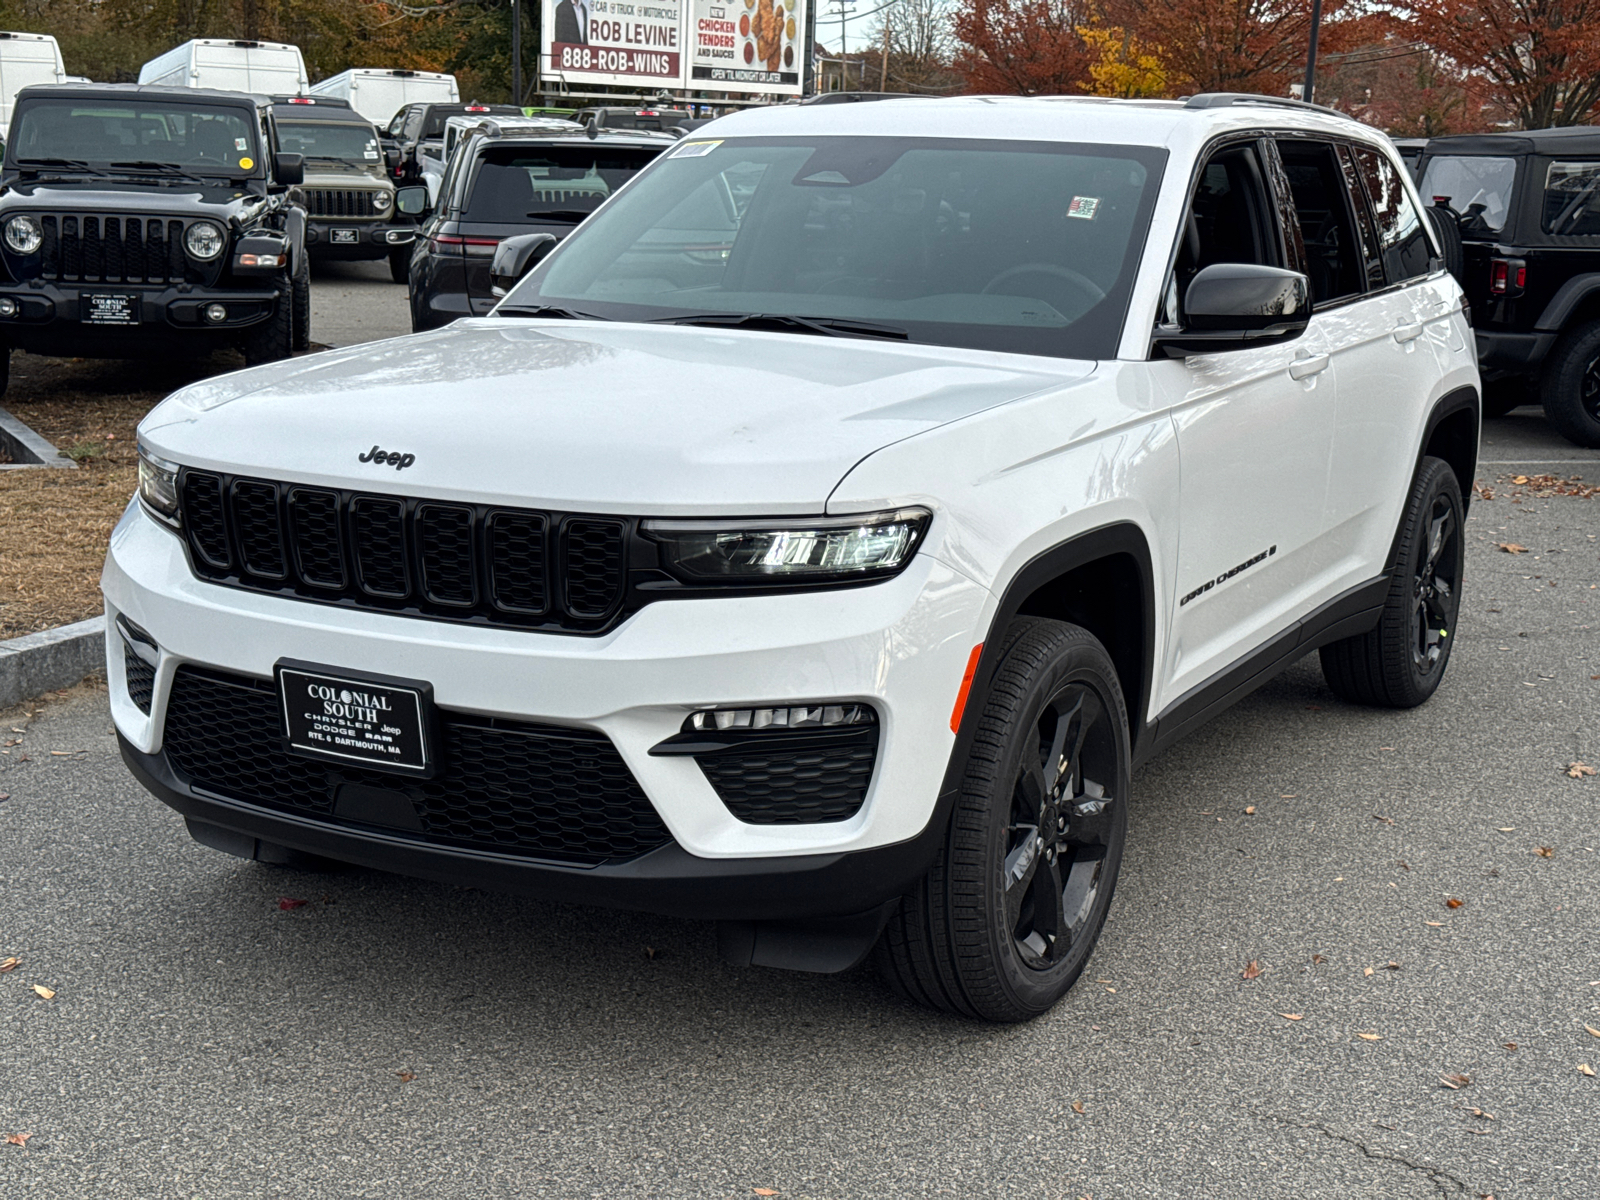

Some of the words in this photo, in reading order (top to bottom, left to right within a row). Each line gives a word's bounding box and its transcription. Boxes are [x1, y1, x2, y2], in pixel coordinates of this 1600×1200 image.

[590, 19, 621, 42] ROB
[625, 22, 677, 47] LEVINE
[698, 18, 736, 33] CHICKEN
[698, 33, 735, 48] TENDERS
[562, 46, 670, 74] 888-ROB-WINS
[697, 48, 711, 57] AND
[712, 49, 734, 59] SAUCES
[358, 445, 416, 471] Jeep
[307, 684, 392, 711] COLONIAL
[324, 701, 378, 723] SOUTH
[304, 713, 372, 729] CHRYSLER
[381, 725, 401, 735] Jeep
[313, 722, 356, 737] DODGE
[364, 732, 393, 743] RAM
[308, 731, 325, 742] RTE.
[326, 734, 332, 743] 6
[335, 737, 386, 752] DARTMOUTH,
[388, 746, 401, 754] MA
